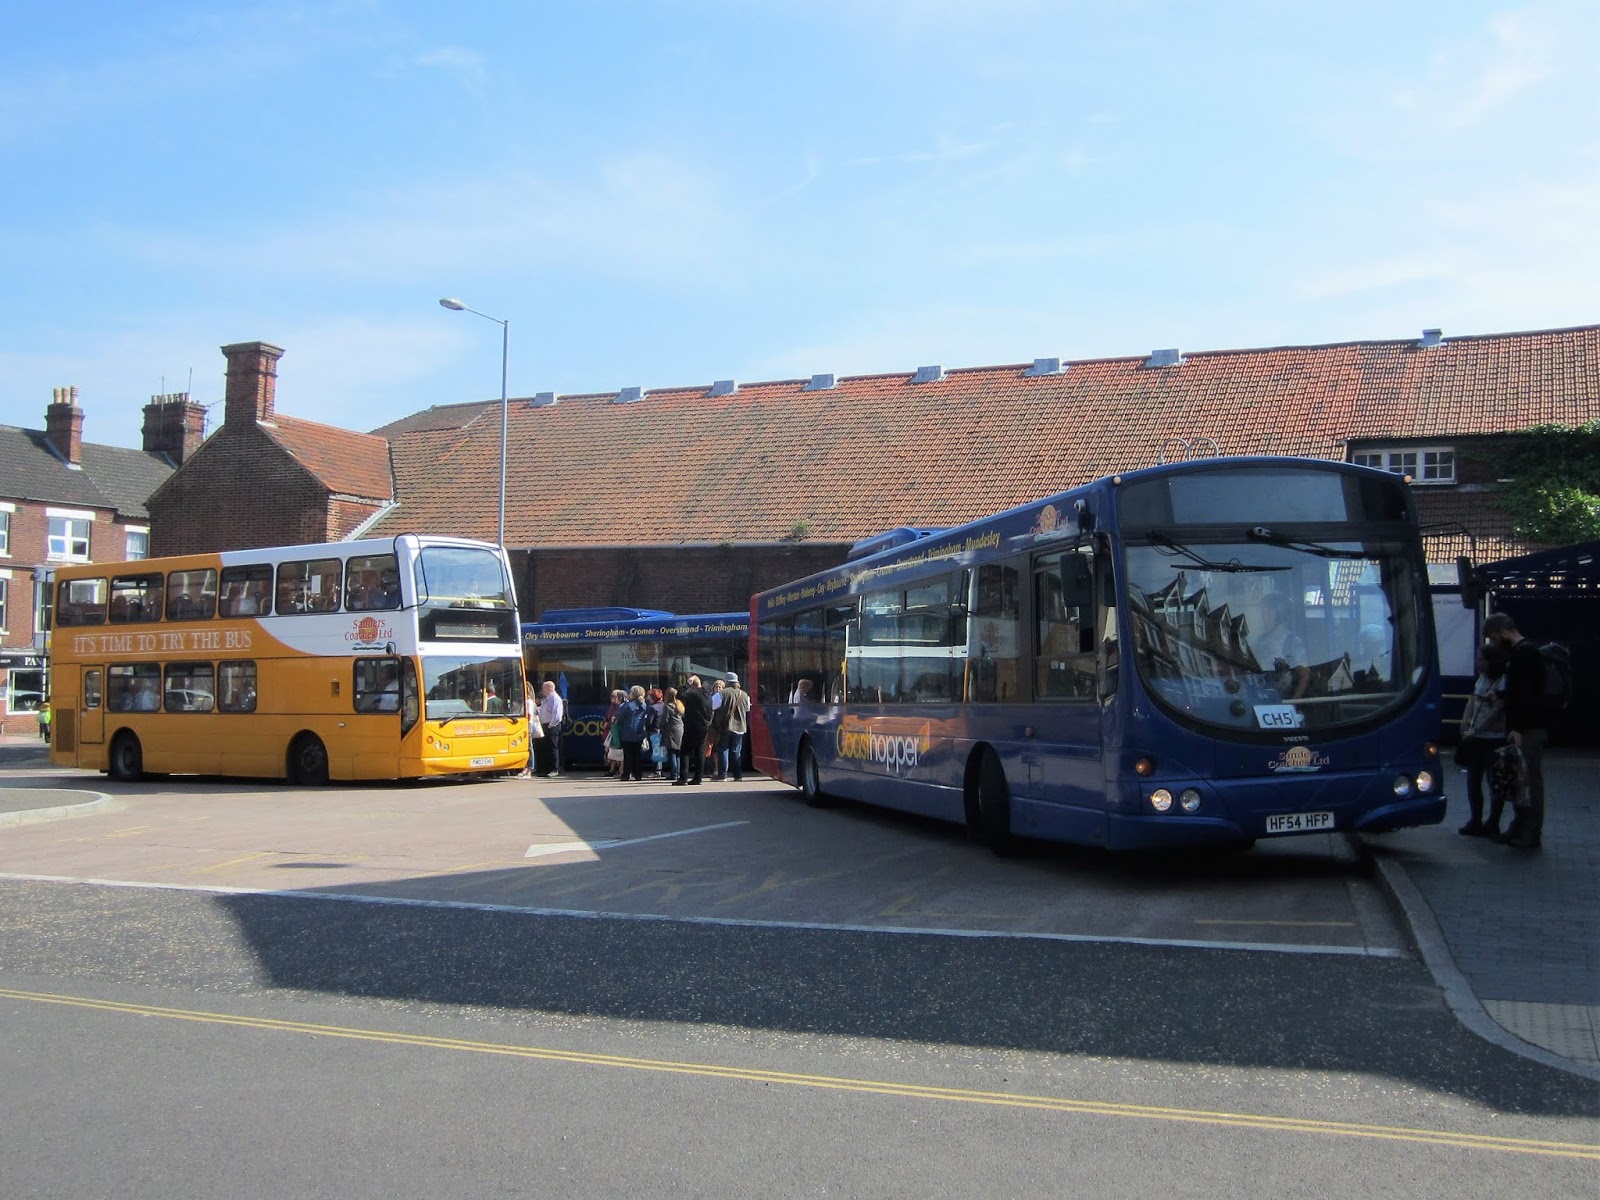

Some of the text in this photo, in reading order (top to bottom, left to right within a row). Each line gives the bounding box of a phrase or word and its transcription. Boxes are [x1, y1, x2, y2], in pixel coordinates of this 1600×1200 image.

[965, 530, 1000, 552] Mundesley
[352, 619, 386, 629] Sanders
[379, 628, 393, 639] Ltd
[525, 623, 748, 641] Cley Weybourne Sheringham Cromer Overstrand Trimingham
[74, 630, 252, 653] IT'S TIME TO TRY THE BUS
[1262, 712, 1293, 726] CH5
[1279, 750, 1320, 761] Sanders
[1313, 756, 1330, 766] Ltd
[1270, 813, 1329, 830] HF54 HFP
